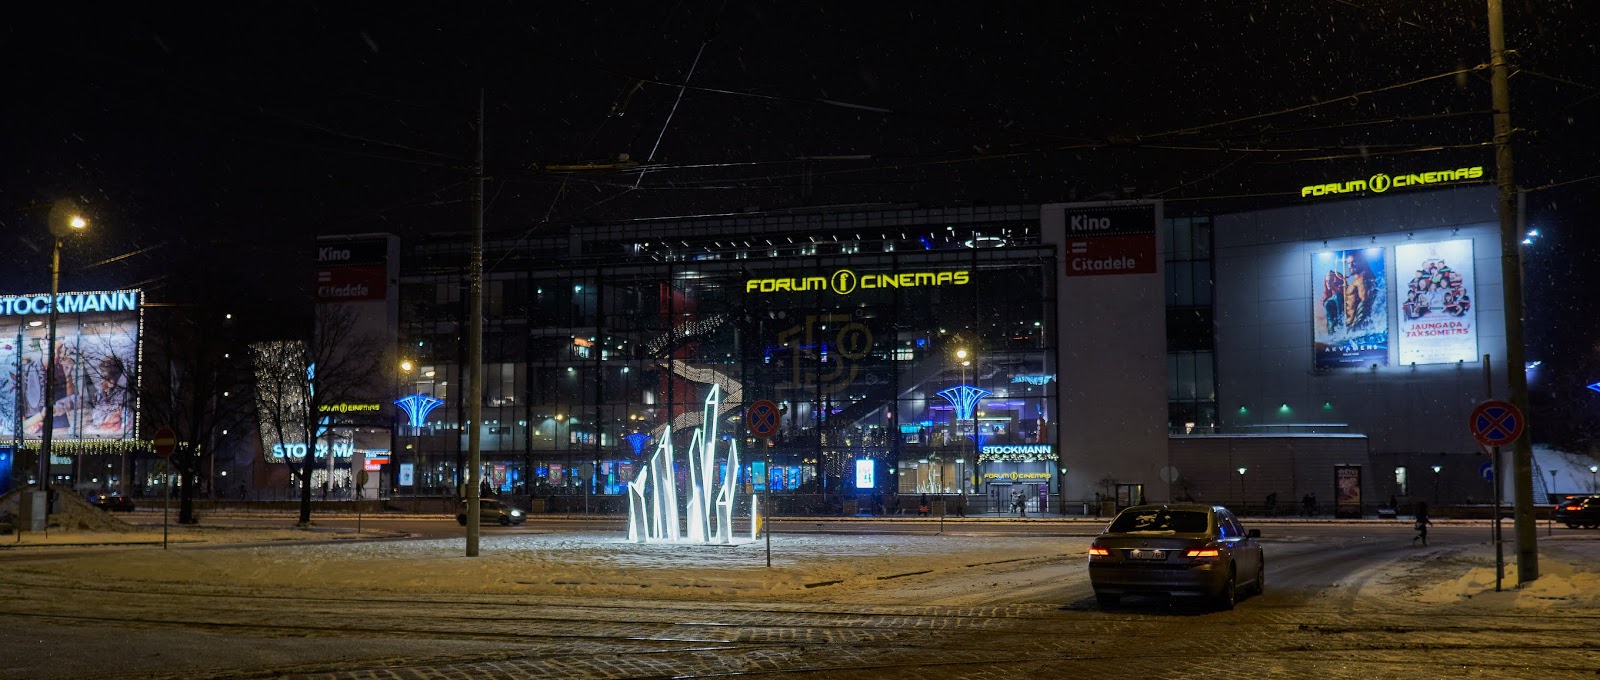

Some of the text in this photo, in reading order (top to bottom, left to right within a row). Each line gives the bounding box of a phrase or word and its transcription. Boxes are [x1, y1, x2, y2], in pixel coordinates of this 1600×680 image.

[1301, 179, 1367, 198] FORUM
[1393, 166, 1483, 187] CINEMAS
[1071, 214, 1111, 231] Kino
[318, 246, 351, 262] Kino
[1071, 255, 1136, 271] Citadele
[746, 276, 827, 293] FORUM
[860, 271, 969, 289] CINEMAS
[1405, 328, 1469, 338] TAKSOMETRS
[1410, 321, 1463, 330] JAUNGADA
[982, 445, 1052, 455] STOCKMANN
[1018, 472, 1052, 480] CINEMAS
